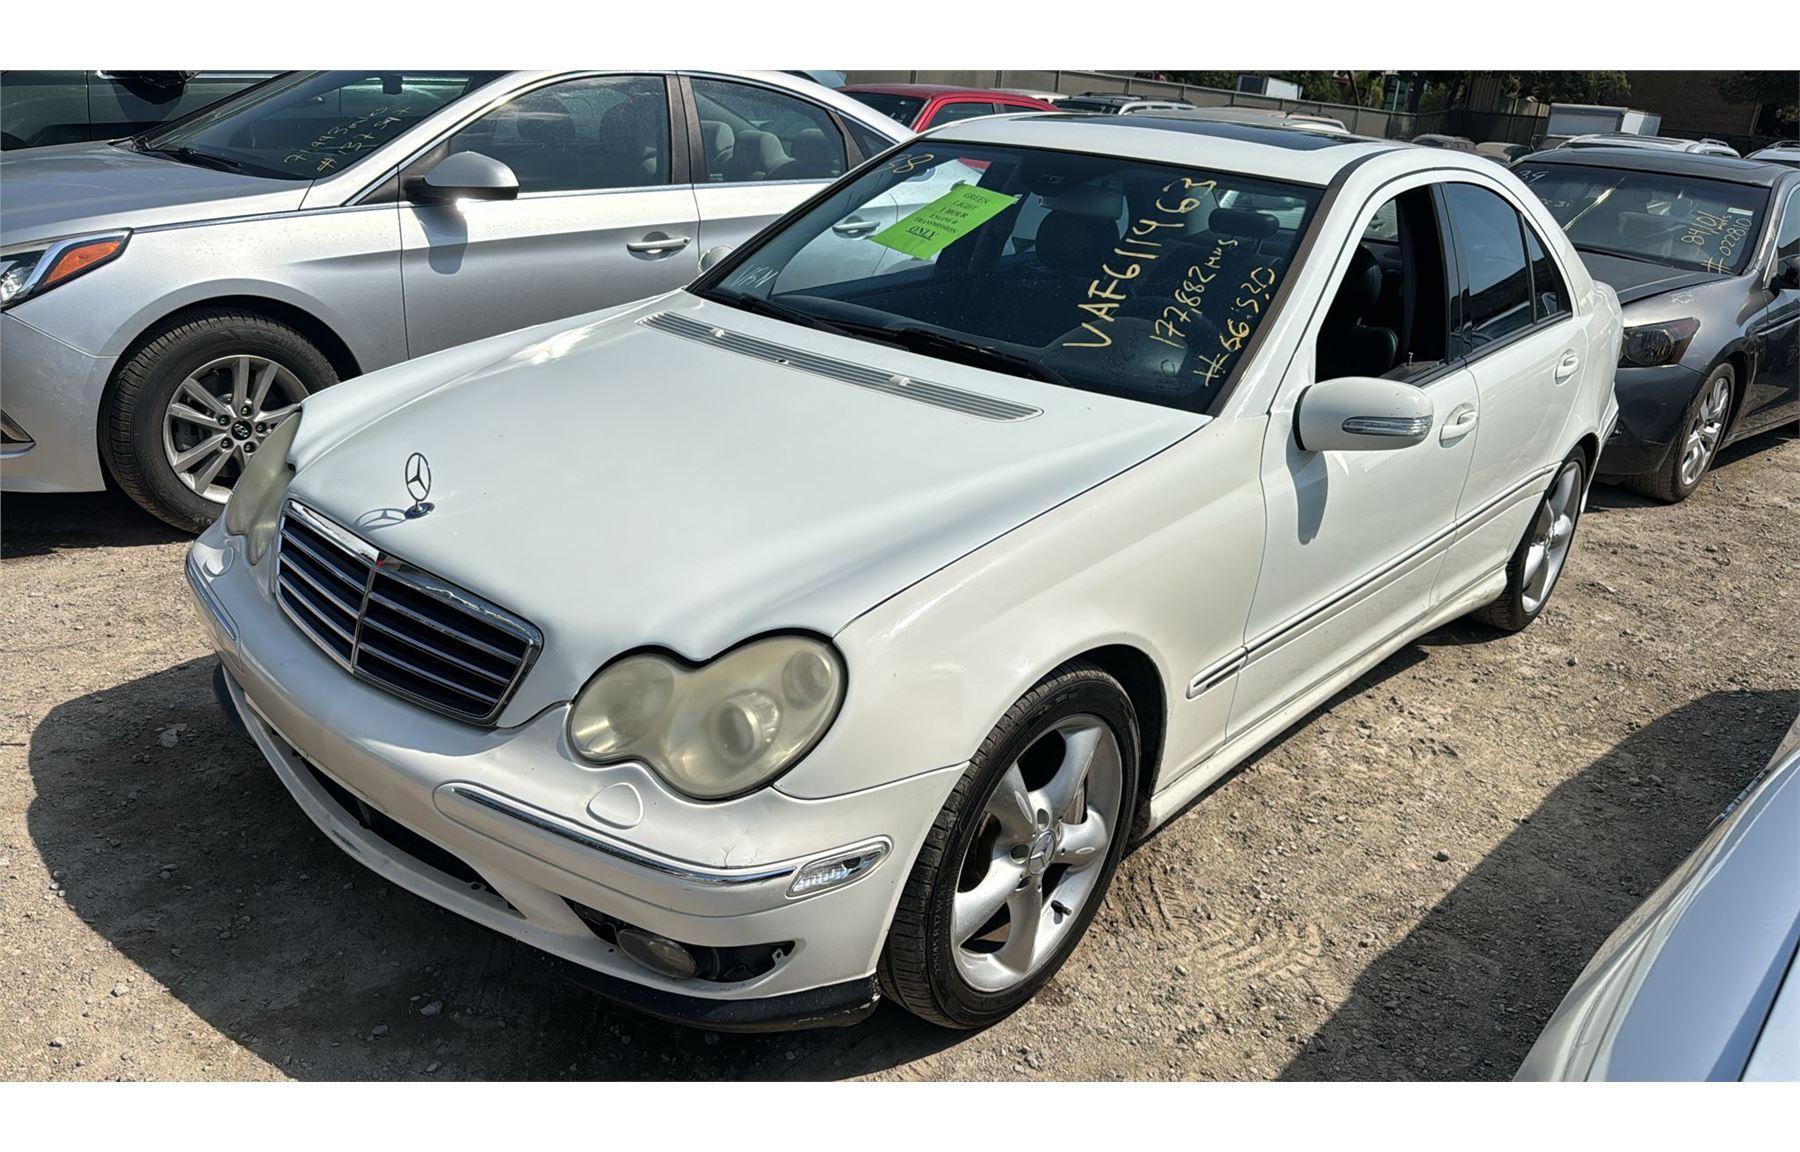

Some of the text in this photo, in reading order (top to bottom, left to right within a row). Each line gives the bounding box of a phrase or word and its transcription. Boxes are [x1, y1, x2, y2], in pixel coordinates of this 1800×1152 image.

[962, 192, 991, 204] GREEN
[952, 200, 979, 211] LIGHT
[907, 225, 938, 240] ONLY
